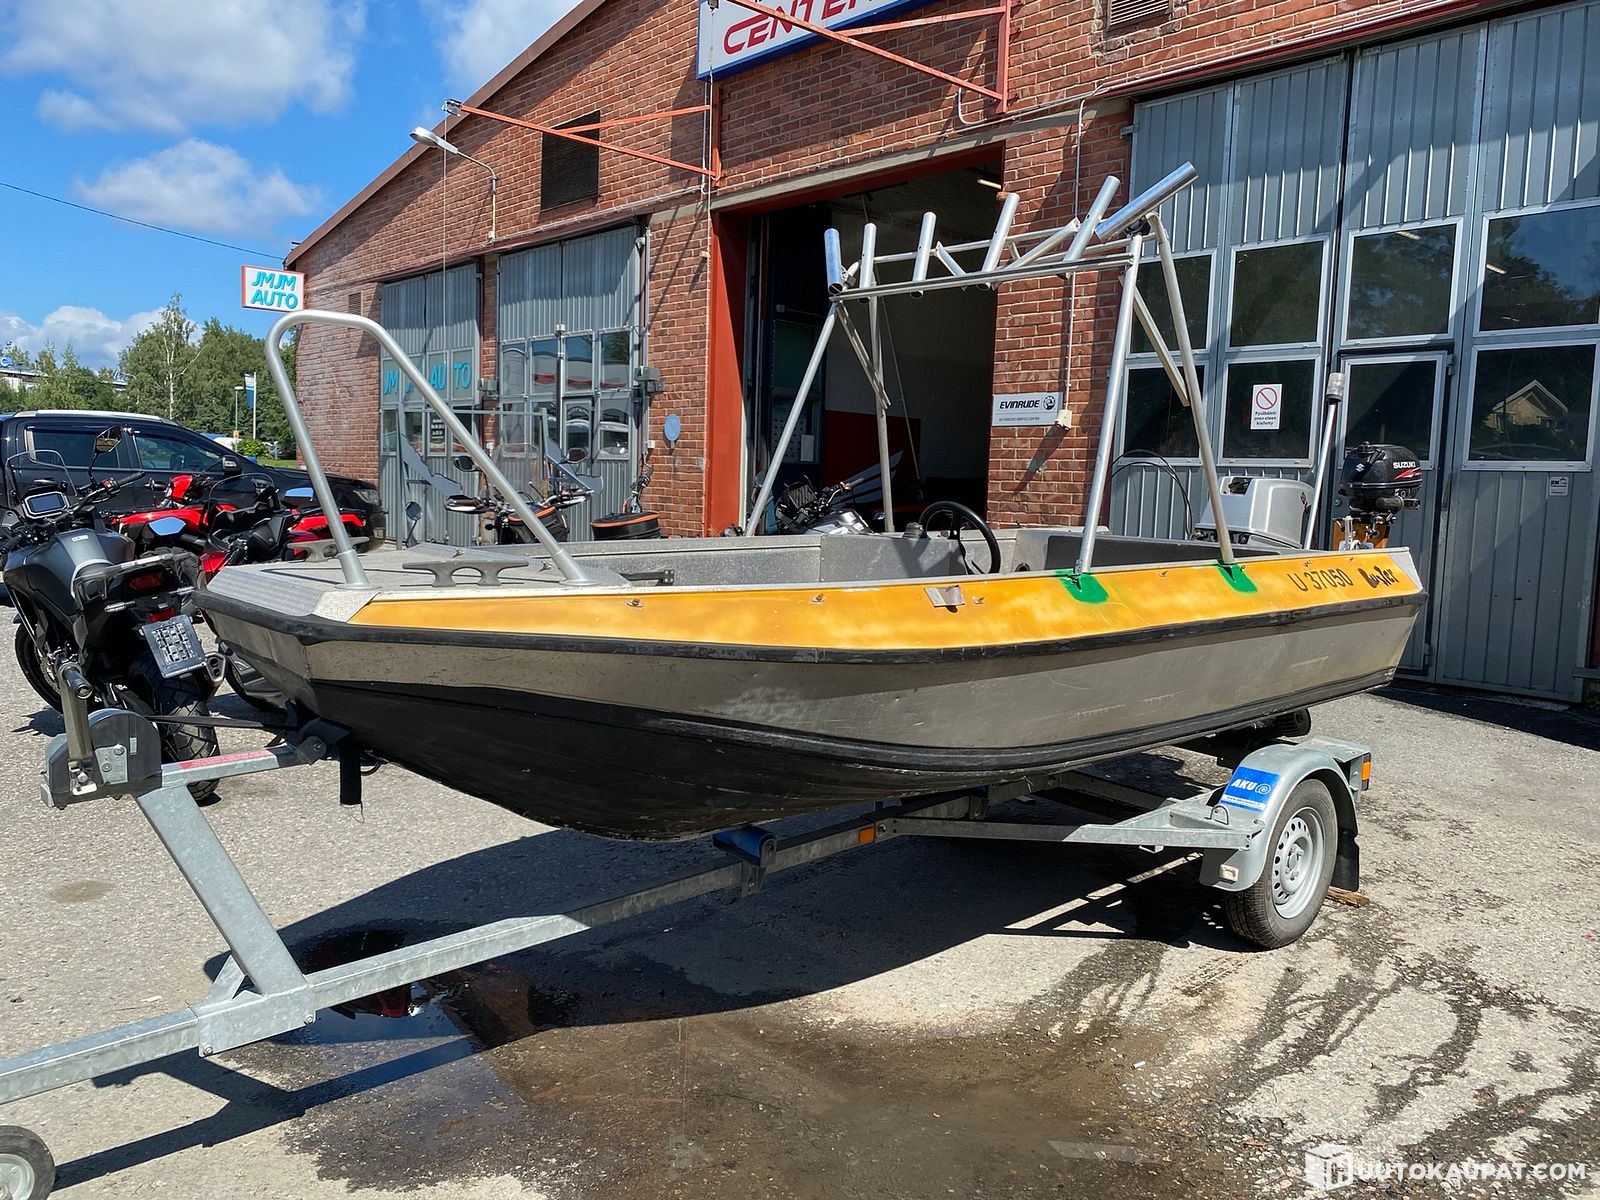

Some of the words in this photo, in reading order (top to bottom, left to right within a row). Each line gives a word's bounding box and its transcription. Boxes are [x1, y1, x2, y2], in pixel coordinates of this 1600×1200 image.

[252, 271, 296, 291] JMJM
[251, 289, 298, 309] AUTO
[430, 362, 471, 390] AUTO
[1000, 400, 1040, 409] EVINRUDE
[1393, 461, 1416, 469] SUZUKI
[1286, 572, 1308, 592] U
[1304, 567, 1354, 591] 37050
[1231, 778, 1257, 791] AKU
